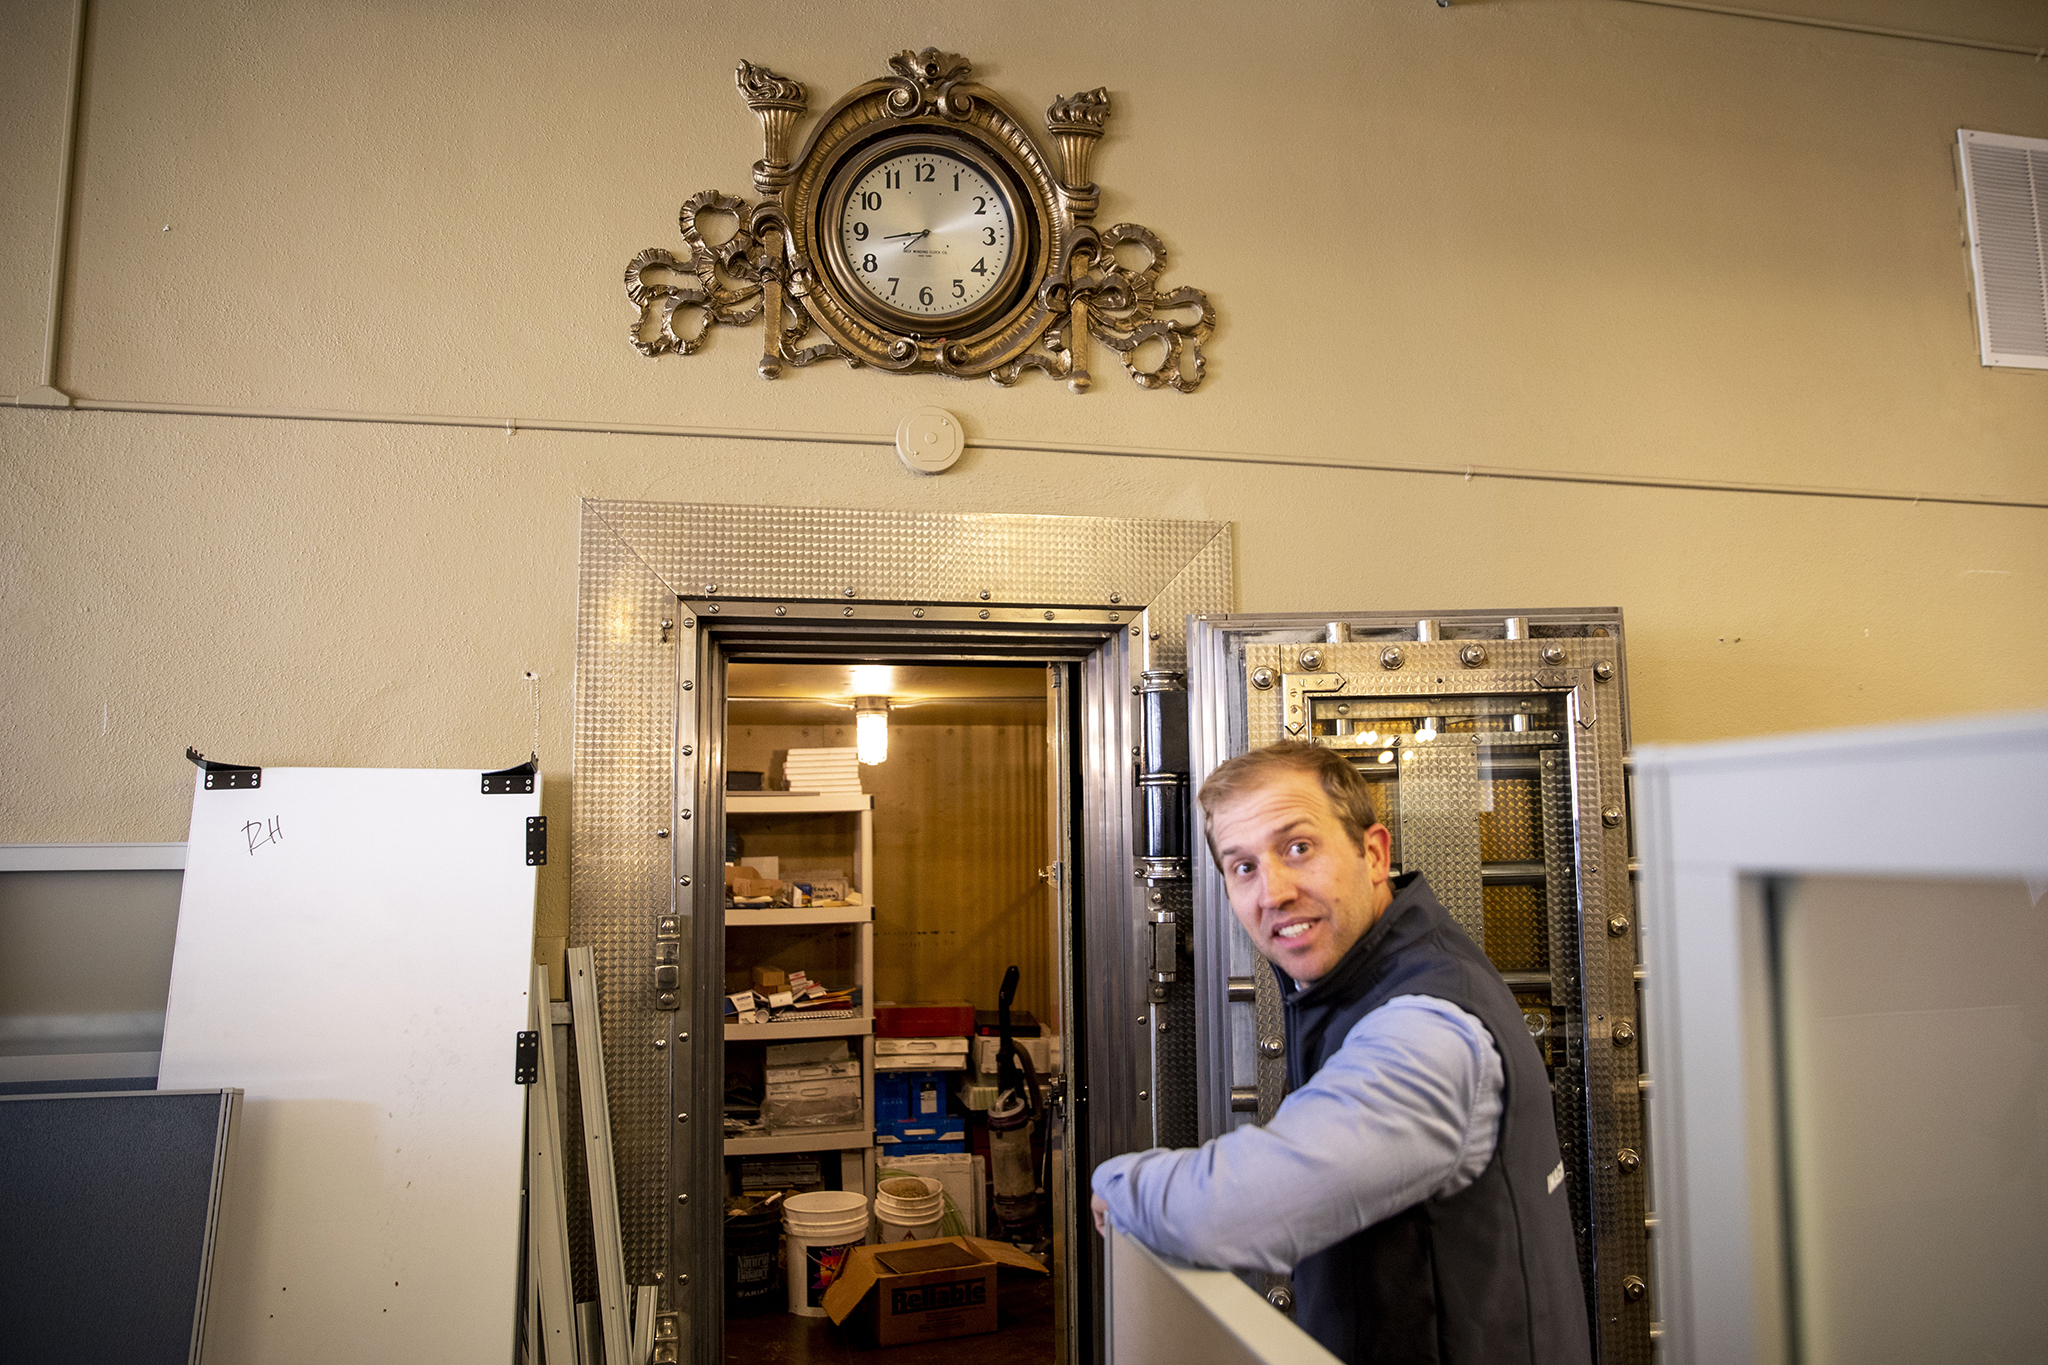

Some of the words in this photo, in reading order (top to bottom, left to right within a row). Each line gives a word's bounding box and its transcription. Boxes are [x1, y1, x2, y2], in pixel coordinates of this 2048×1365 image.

[885, 169, 901, 190] 11
[914, 162, 936, 183] 12
[953, 172, 960, 192] 1
[860, 191, 882, 211] 10
[972, 195, 987, 215] 2
[853, 222, 869, 241] 9
[982, 226, 996, 246] 3
[862, 253, 878, 273] 8
[970, 256, 988, 277] 4
[887, 277, 900, 296] 7
[918, 286, 934, 306] 6
[951, 279, 965, 299] 5
[737, 1252, 770, 1268] Natural
[744, 1287, 769, 1298] ARIAT
[891, 1283, 987, 1312] Reliable
